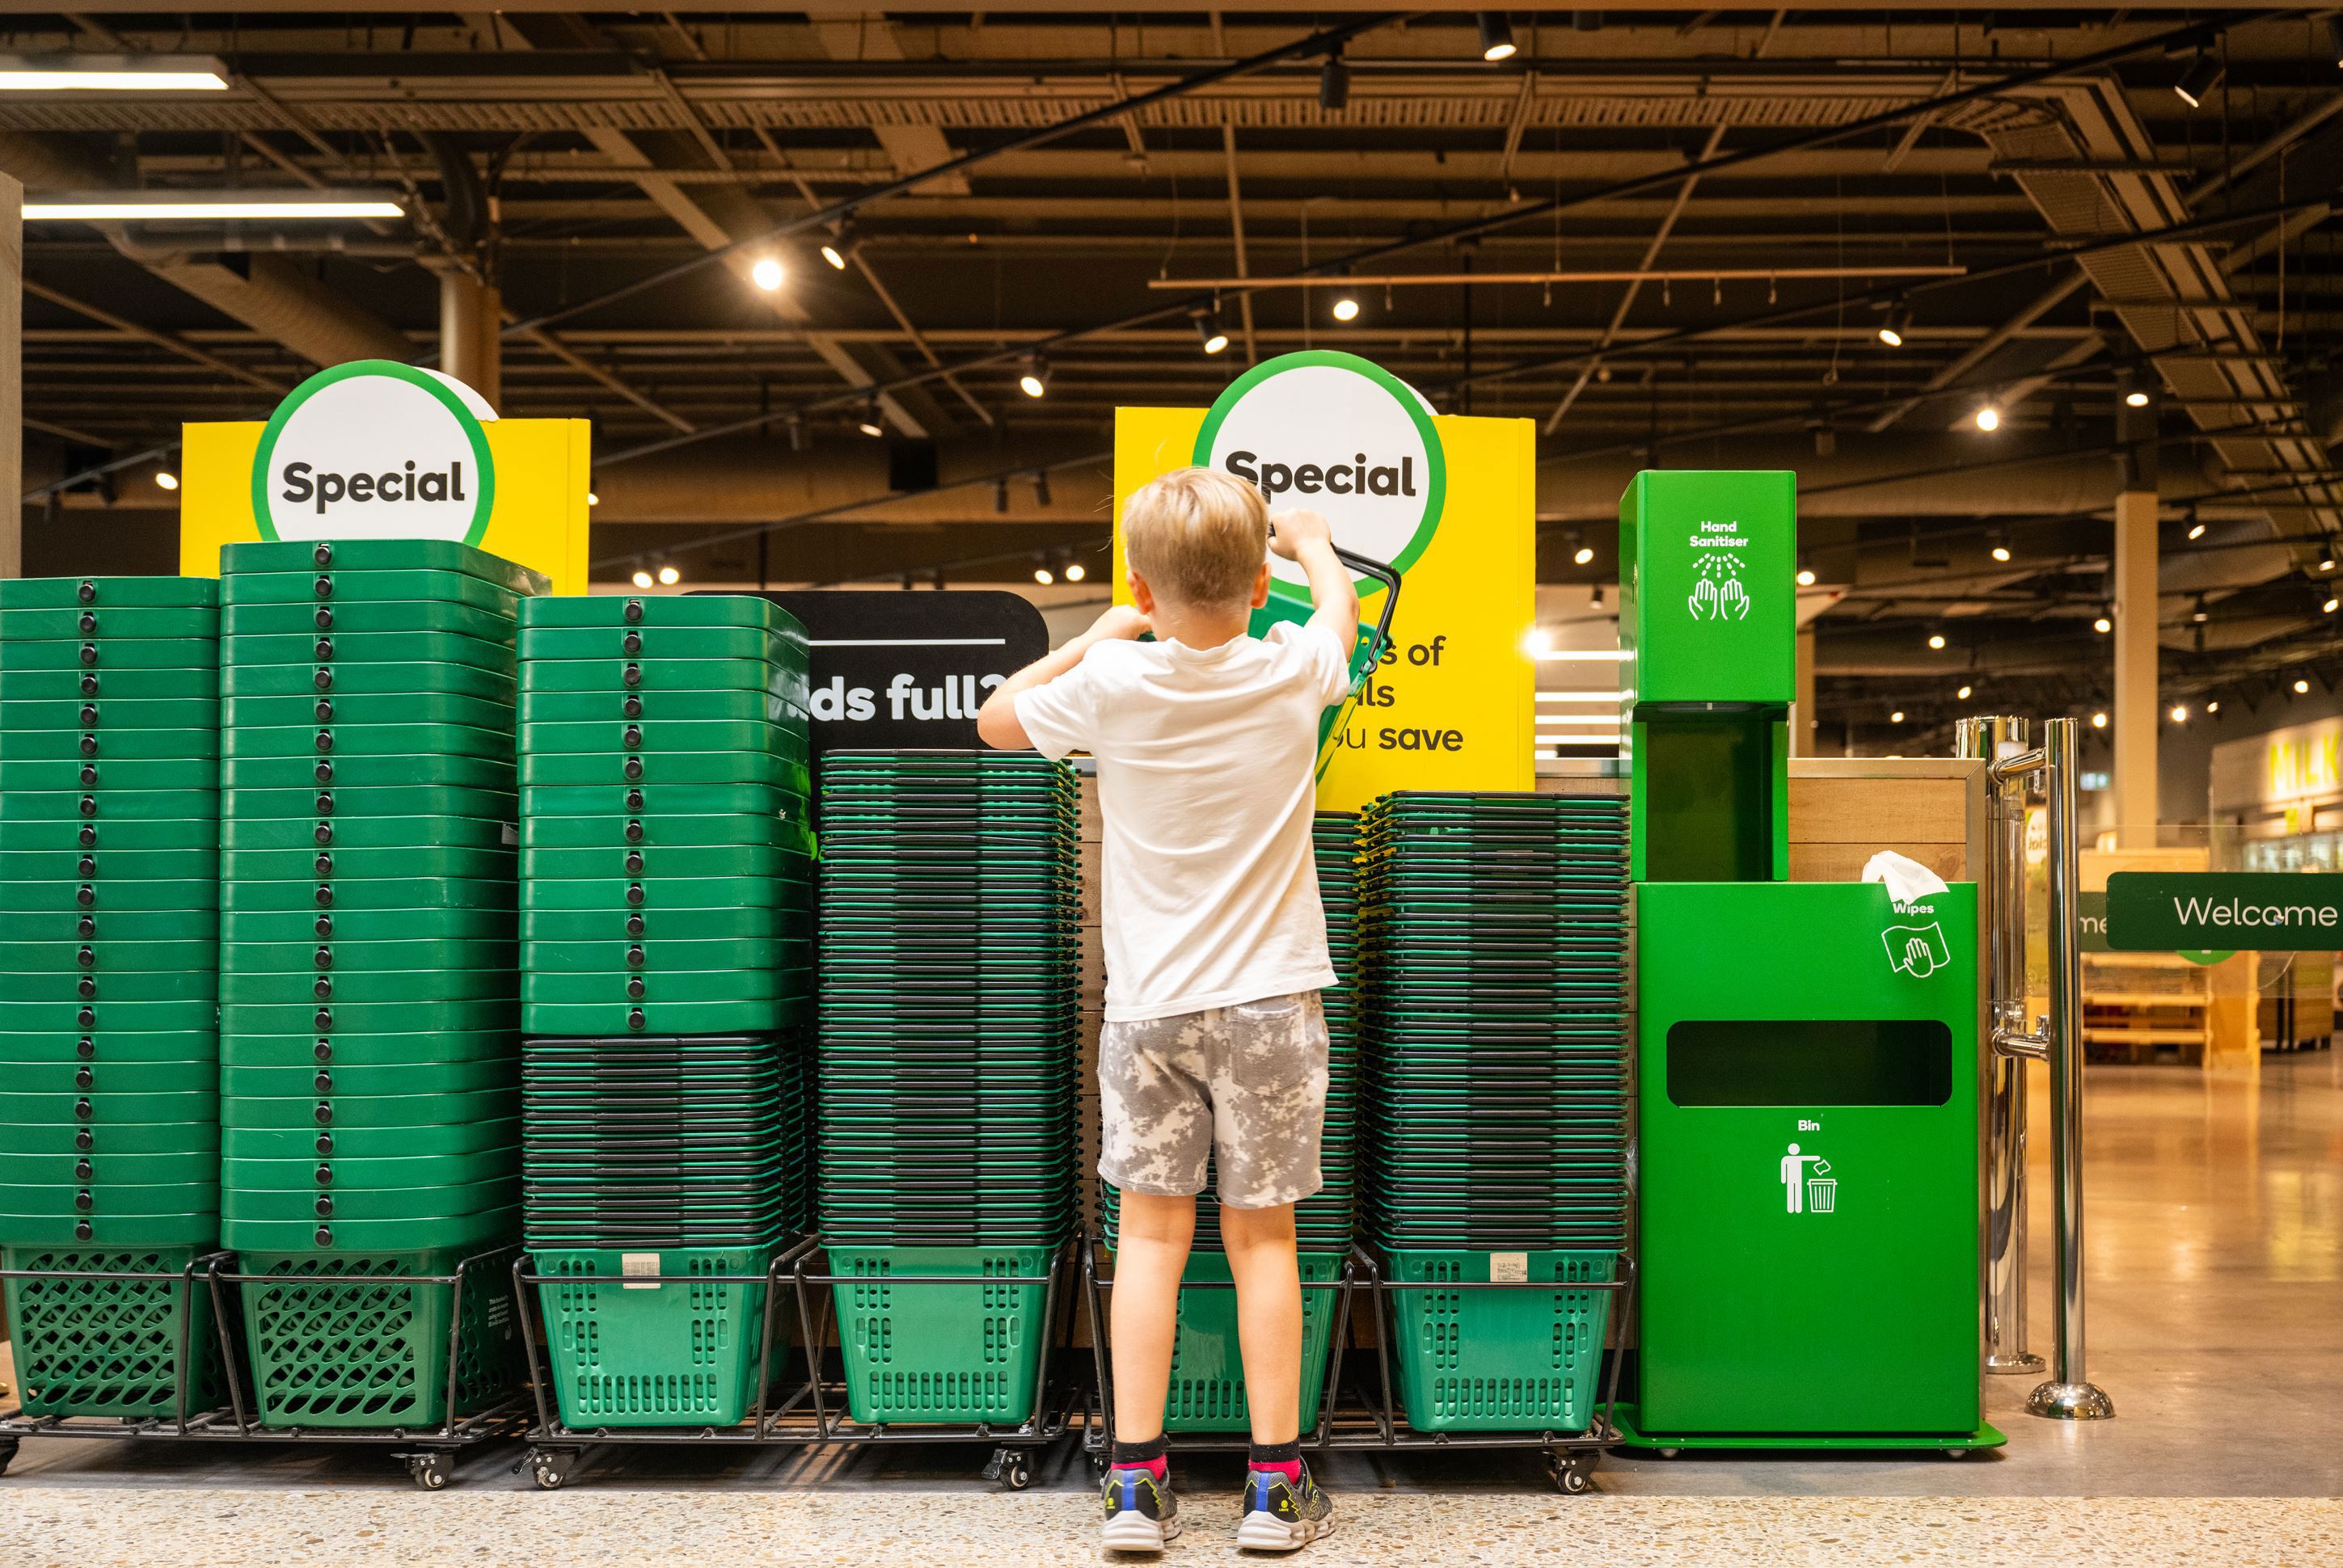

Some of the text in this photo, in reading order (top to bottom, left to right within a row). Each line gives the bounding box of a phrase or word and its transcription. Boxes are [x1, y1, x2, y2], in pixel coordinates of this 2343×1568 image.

[282, 460, 465, 514] Special
[1225, 450, 1416, 505] Special
[1700, 521, 1737, 533] Hand
[1689, 535, 1749, 547] Sanitiser
[1408, 635, 1447, 666] of
[1378, 727, 1463, 752] save
[2269, 730, 2341, 792] MILK
[1893, 903, 1935, 917] Wipes
[2173, 896, 2338, 926] Welcome
[1797, 1119, 1820, 1132] Bin
